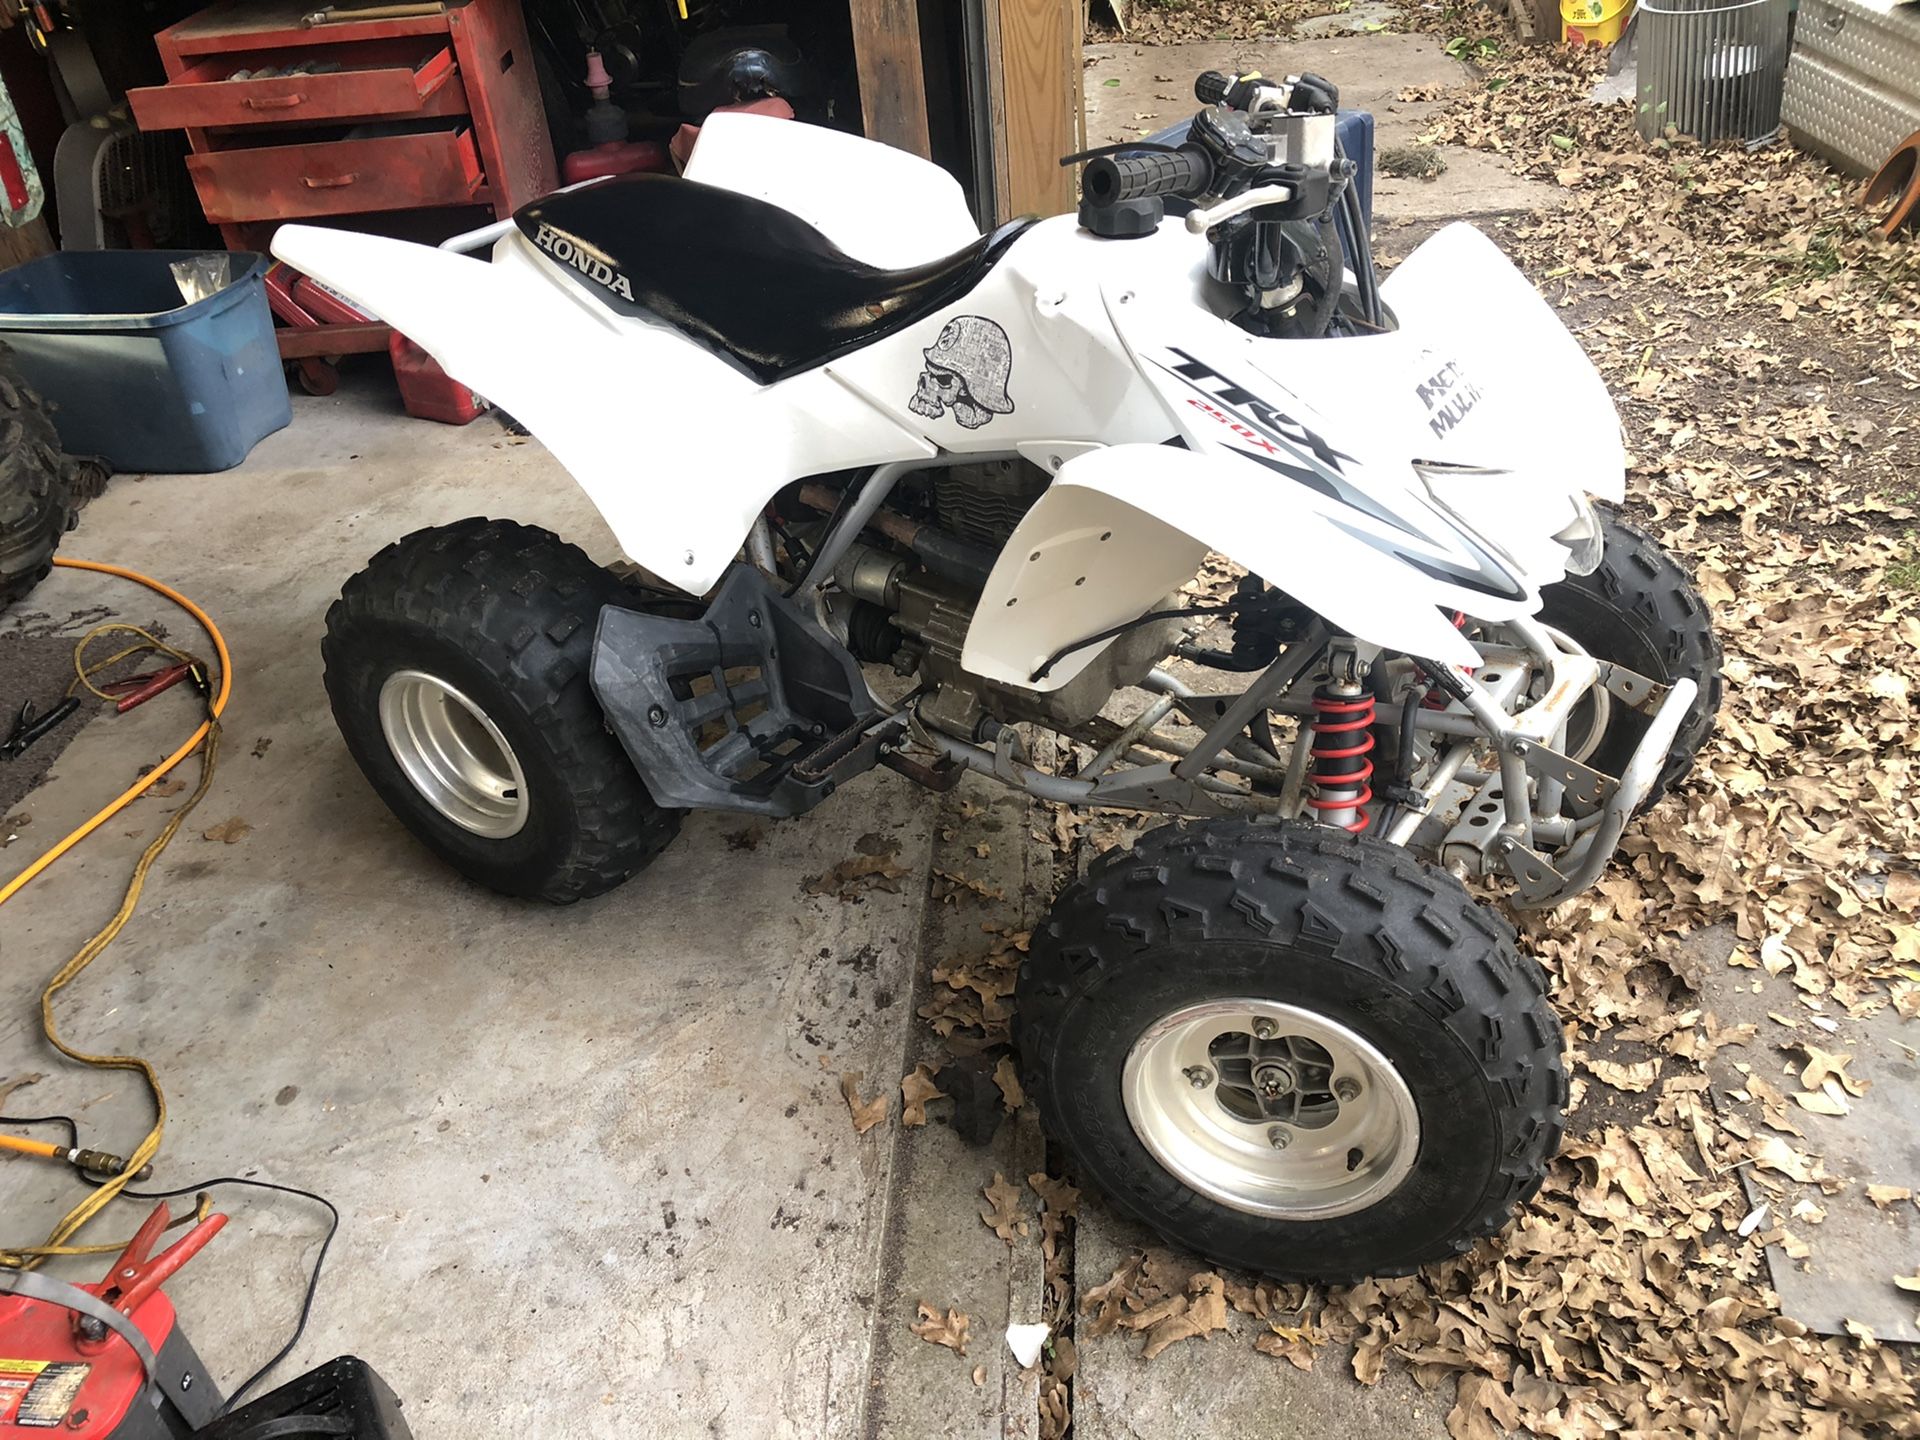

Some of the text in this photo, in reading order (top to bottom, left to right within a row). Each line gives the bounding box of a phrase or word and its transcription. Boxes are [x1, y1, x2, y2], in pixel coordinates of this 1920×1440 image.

[534, 225, 635, 302] HONDA
[1164, 346, 1364, 476] TRX
[1415, 359, 1464, 411] MET
[1428, 383, 1482, 440] MULI
[1186, 398, 1281, 455] 250X
